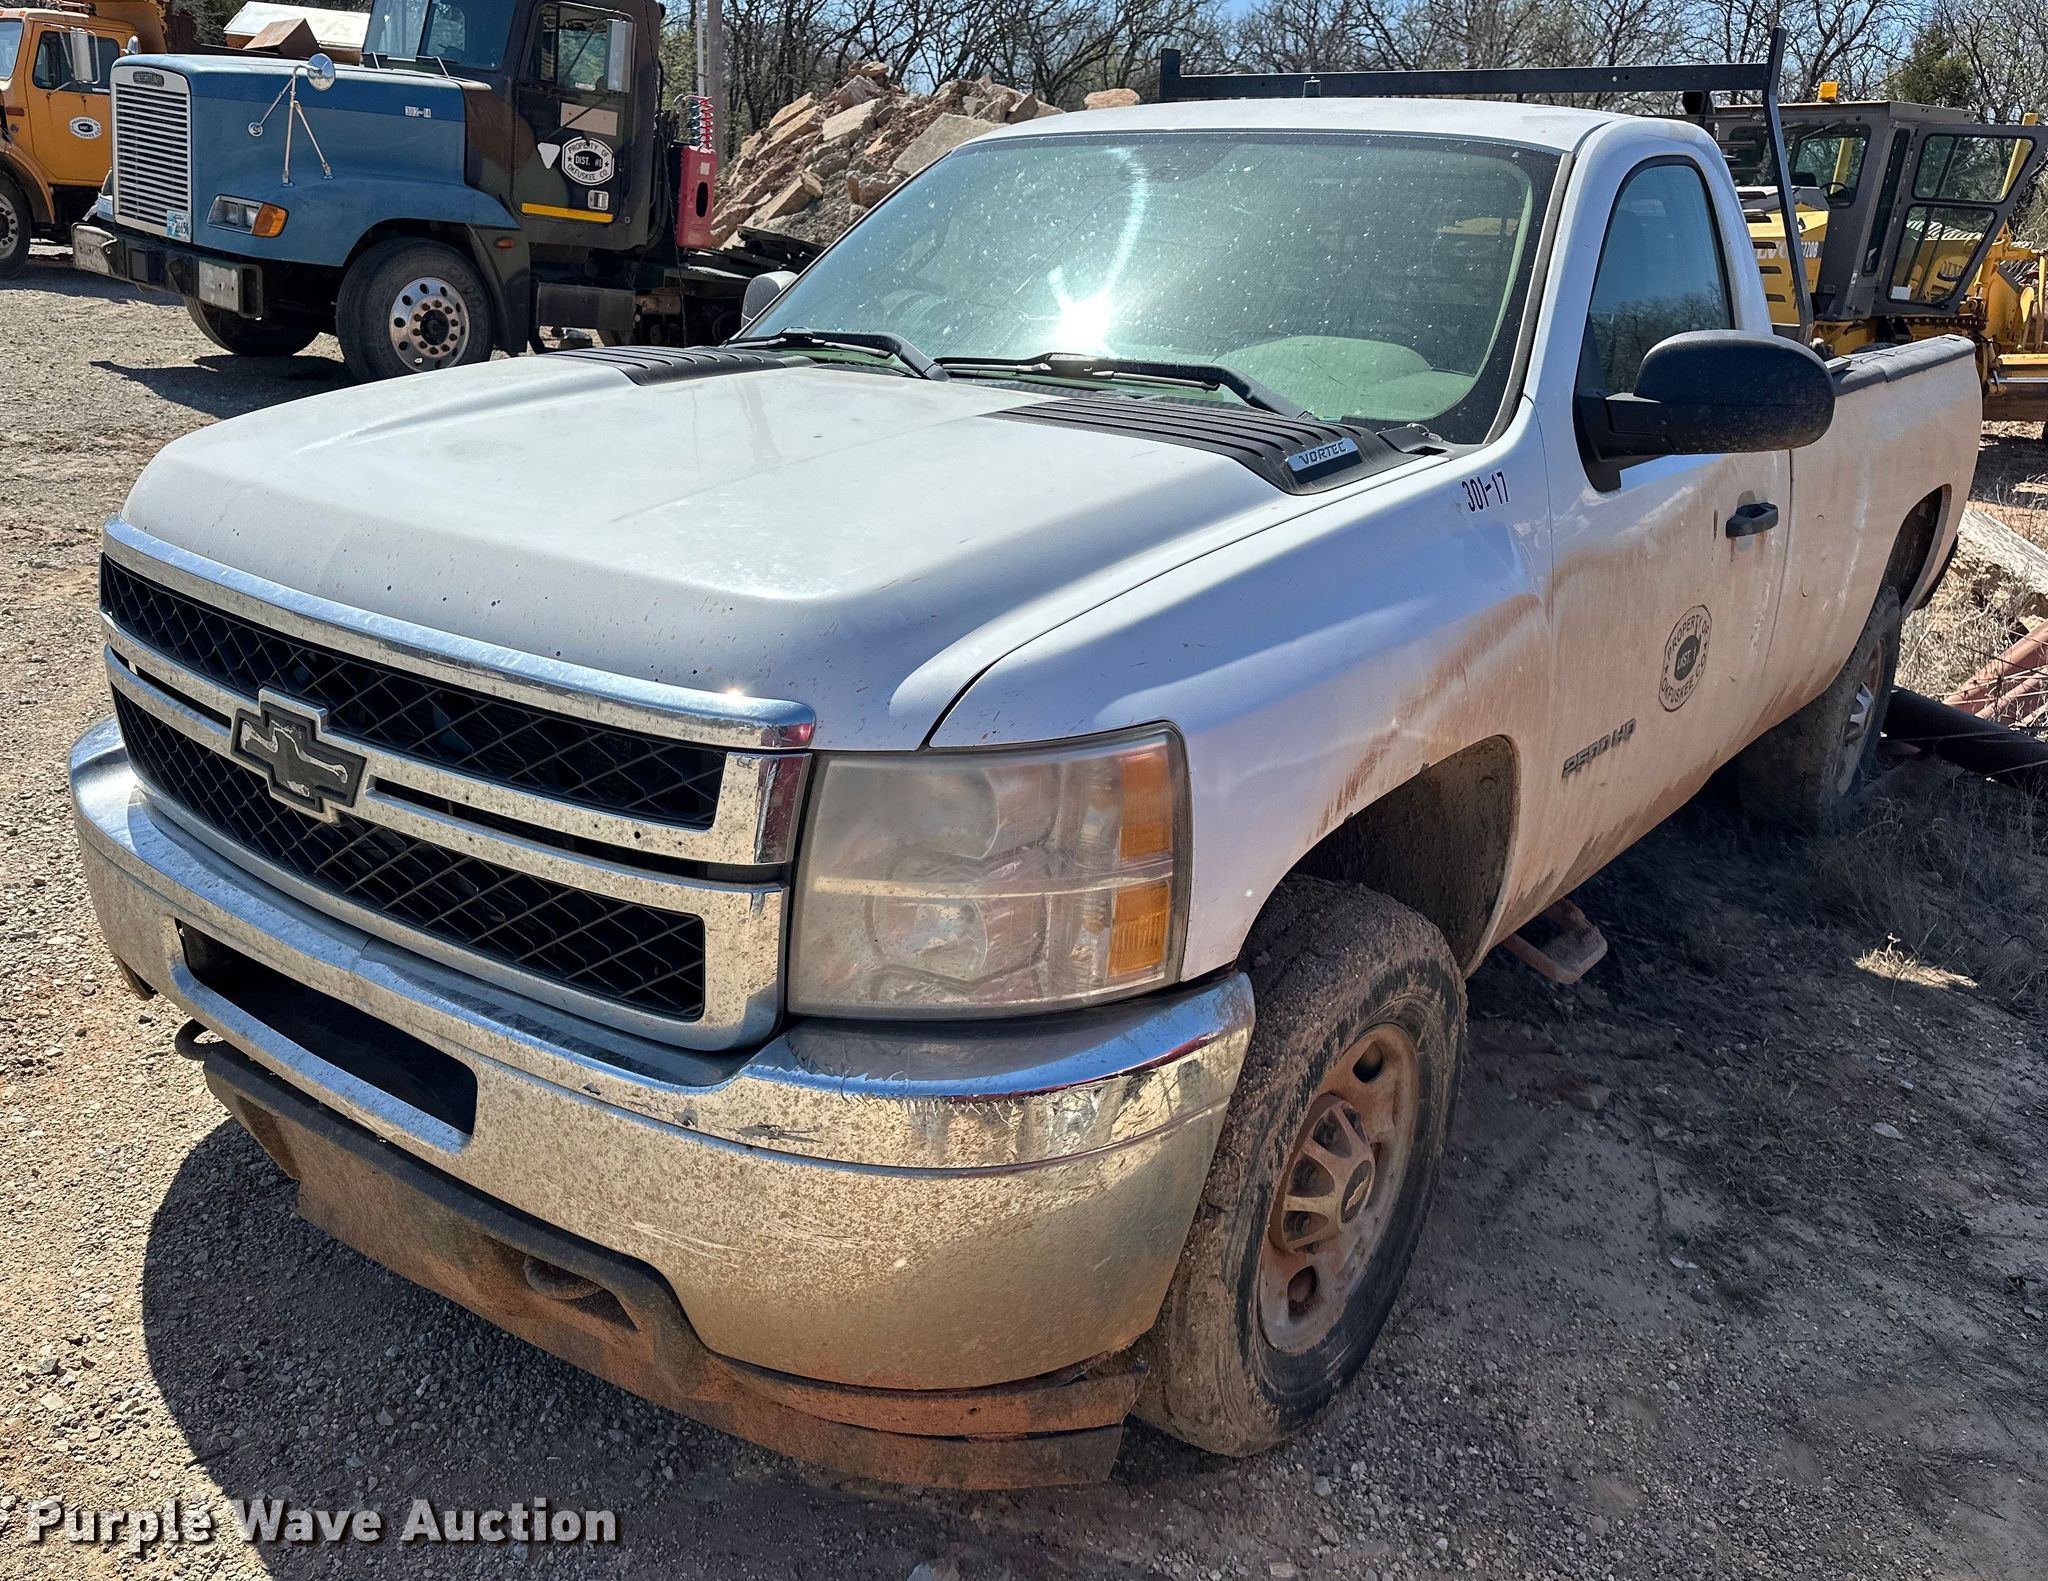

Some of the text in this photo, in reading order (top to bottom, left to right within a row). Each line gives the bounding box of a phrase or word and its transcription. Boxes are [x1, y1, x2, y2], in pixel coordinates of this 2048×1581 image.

[575, 155, 591, 166] DIST.
[601, 149, 610, 158] OF
[566, 163, 598, 181] OKFUSKEE
[1298, 441, 1348, 465] VORTEC
[1461, 471, 1509, 512] 301-17
[1667, 614, 1710, 662] PROPERTY OF
[1661, 677, 1695, 704] OKFUSKEE
